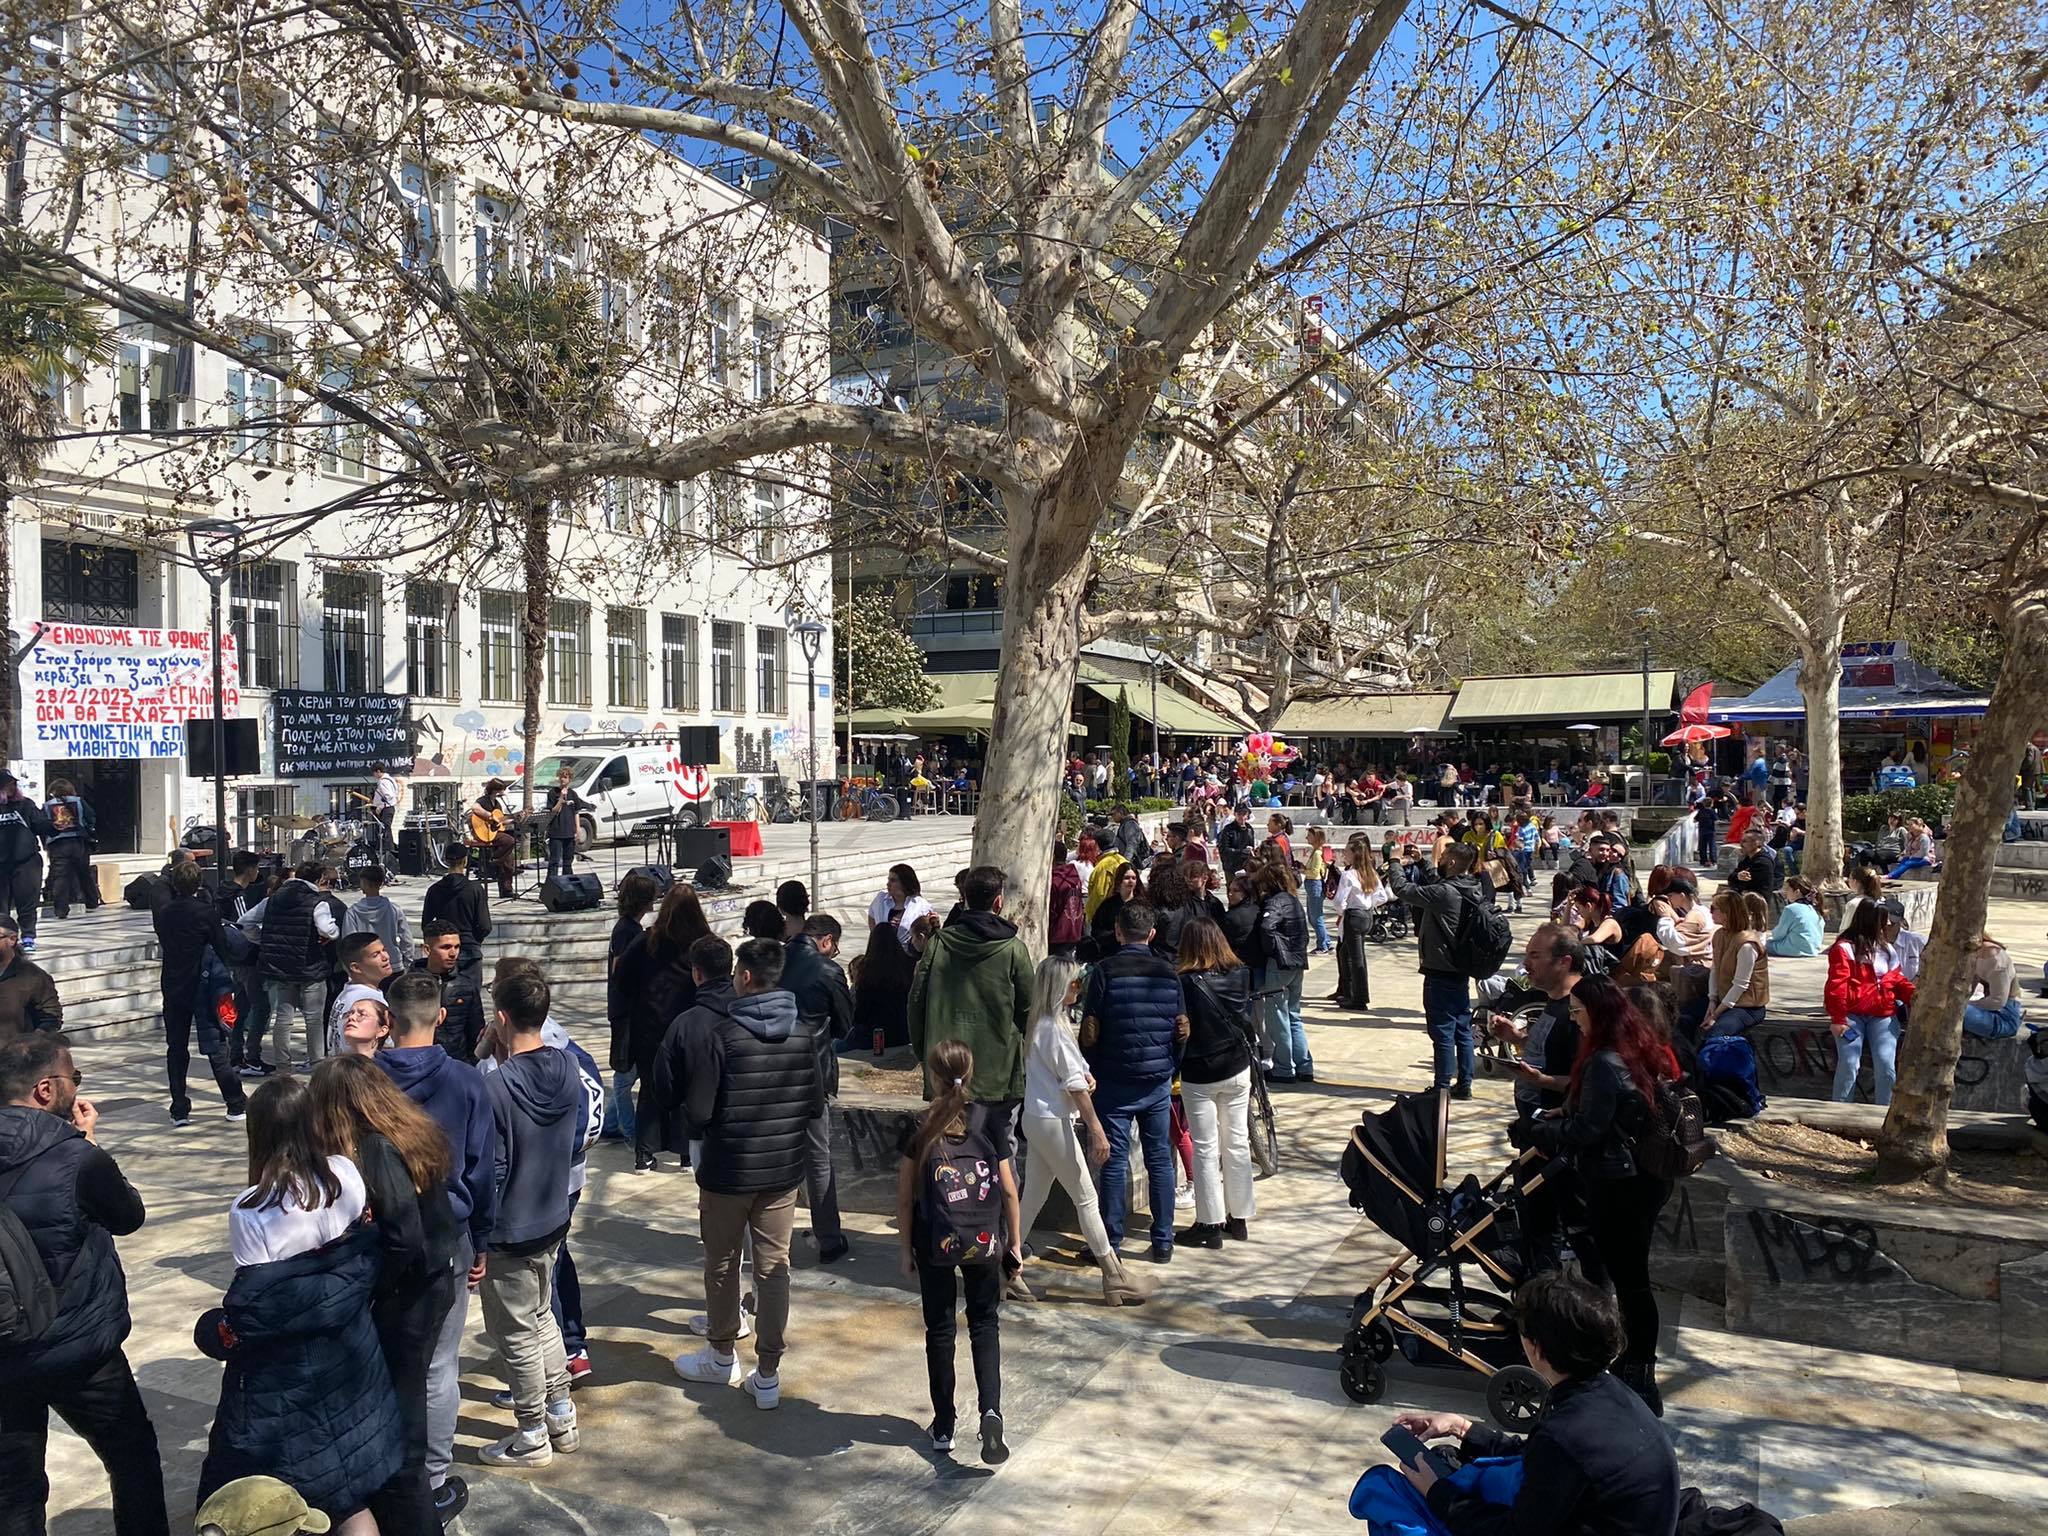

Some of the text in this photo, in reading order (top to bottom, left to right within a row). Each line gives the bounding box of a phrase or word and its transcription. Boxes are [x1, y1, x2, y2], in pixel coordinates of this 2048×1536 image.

[139, 630, 162, 647] ΤΙΣ
[168, 630, 210, 650] ΦΩΝΕΣ
[34, 648, 70, 665] Στον
[74, 650, 112, 672] δρόμο
[118, 657, 140, 667] του
[34, 667, 170, 691] κερδίζει η ζωή!
[36, 688, 133, 706] 28/2/2023
[280, 697, 292, 708] ΤΑ
[298, 696, 332, 709] ΚΕΡΔΗ
[337, 697, 355, 709] ΤΩΝ
[37, 706, 64, 722] ΔΕΝ
[75, 706, 97, 721] ΘΑ
[282, 715, 295, 727] ΤΟ
[298, 714, 322, 724] ΑΙΜΑ
[327, 714, 349, 724] ΤΩΝ
[38, 724, 152, 741] ΣΥΝΤΟΝΙΣΤΙΚΗ
[282, 728, 407, 743] ΠΟΛΕΜΟ ΣΤΟΝ ΠΟΛΕΜΟ
[68, 741, 186, 758] ΜΑΘΗΤΩΝ ΛΑΡΙ
[283, 743, 306, 756] ΤΩΝ
